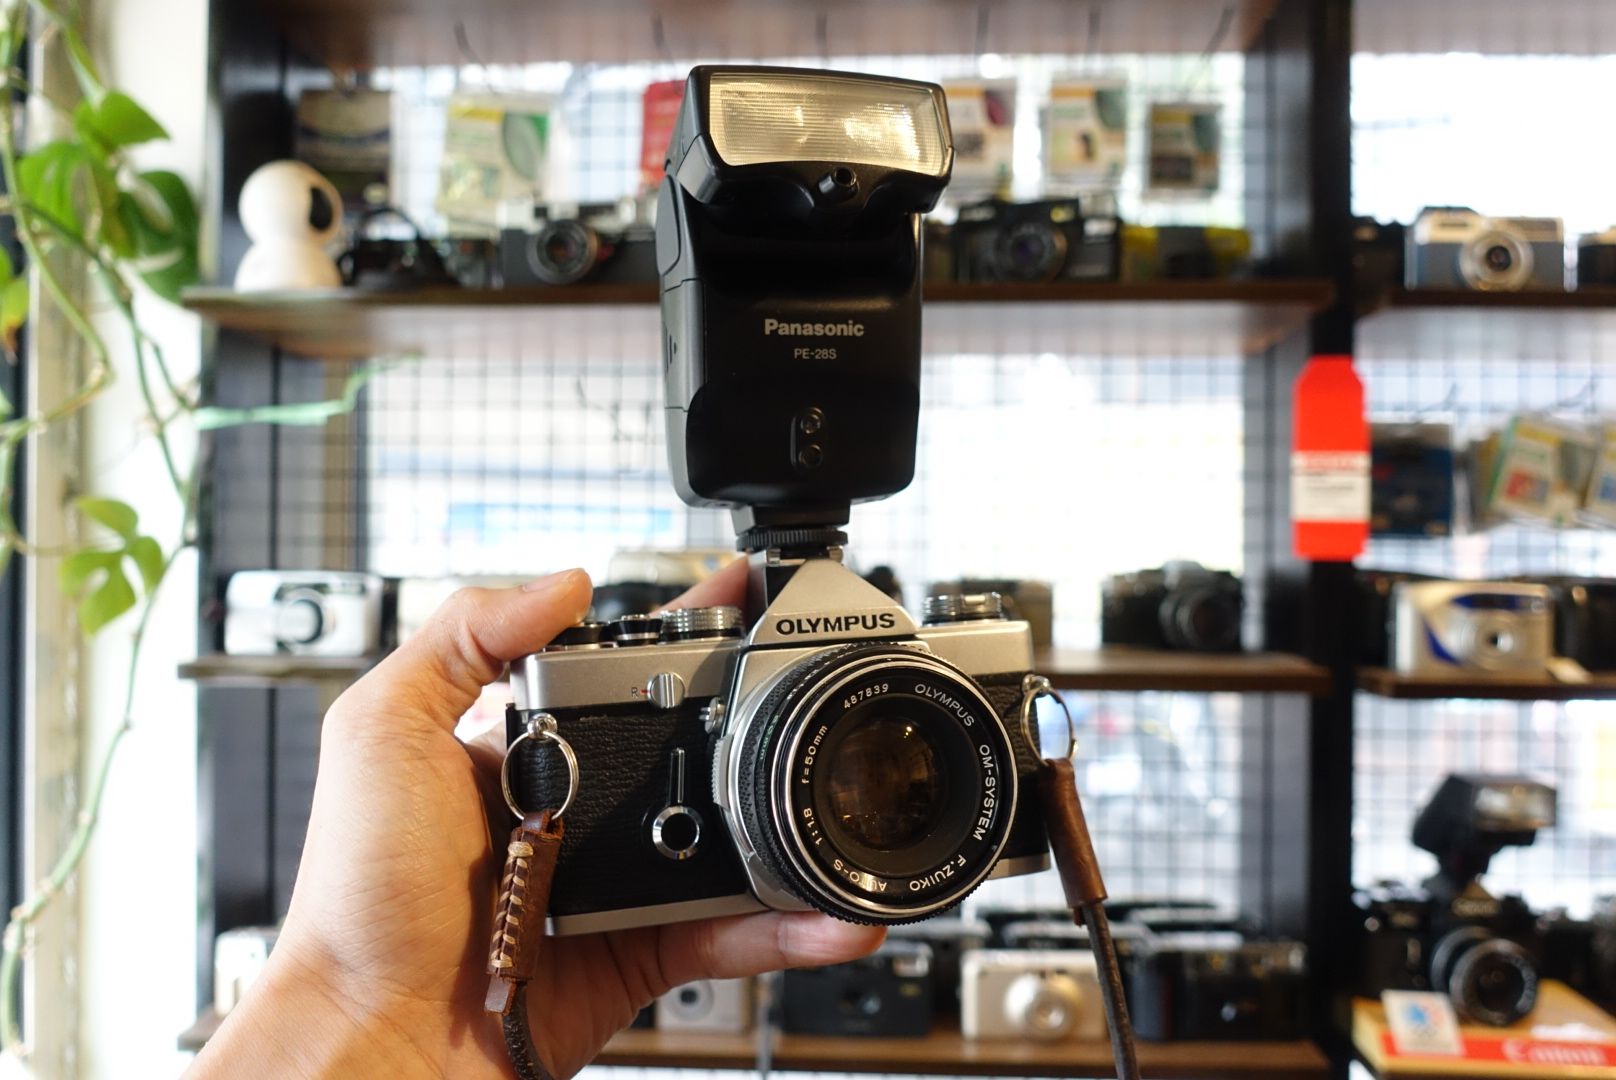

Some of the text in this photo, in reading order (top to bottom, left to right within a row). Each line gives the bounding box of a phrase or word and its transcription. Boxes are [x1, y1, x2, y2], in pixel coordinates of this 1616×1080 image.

[764, 318, 865, 337] Panasonic
[794, 348, 837, 360] PE-28S
[775, 612, 896, 636] OLYMPUS
[631, 686, 639, 698] R
[843, 682, 889, 709] 487839
[914, 683, 975, 727] OLYMPUS
[972, 744, 997, 841] OM-SYSTEM
[803, 807, 823, 846] 1:1.8
[833, 858, 888, 892] AUTO-S
